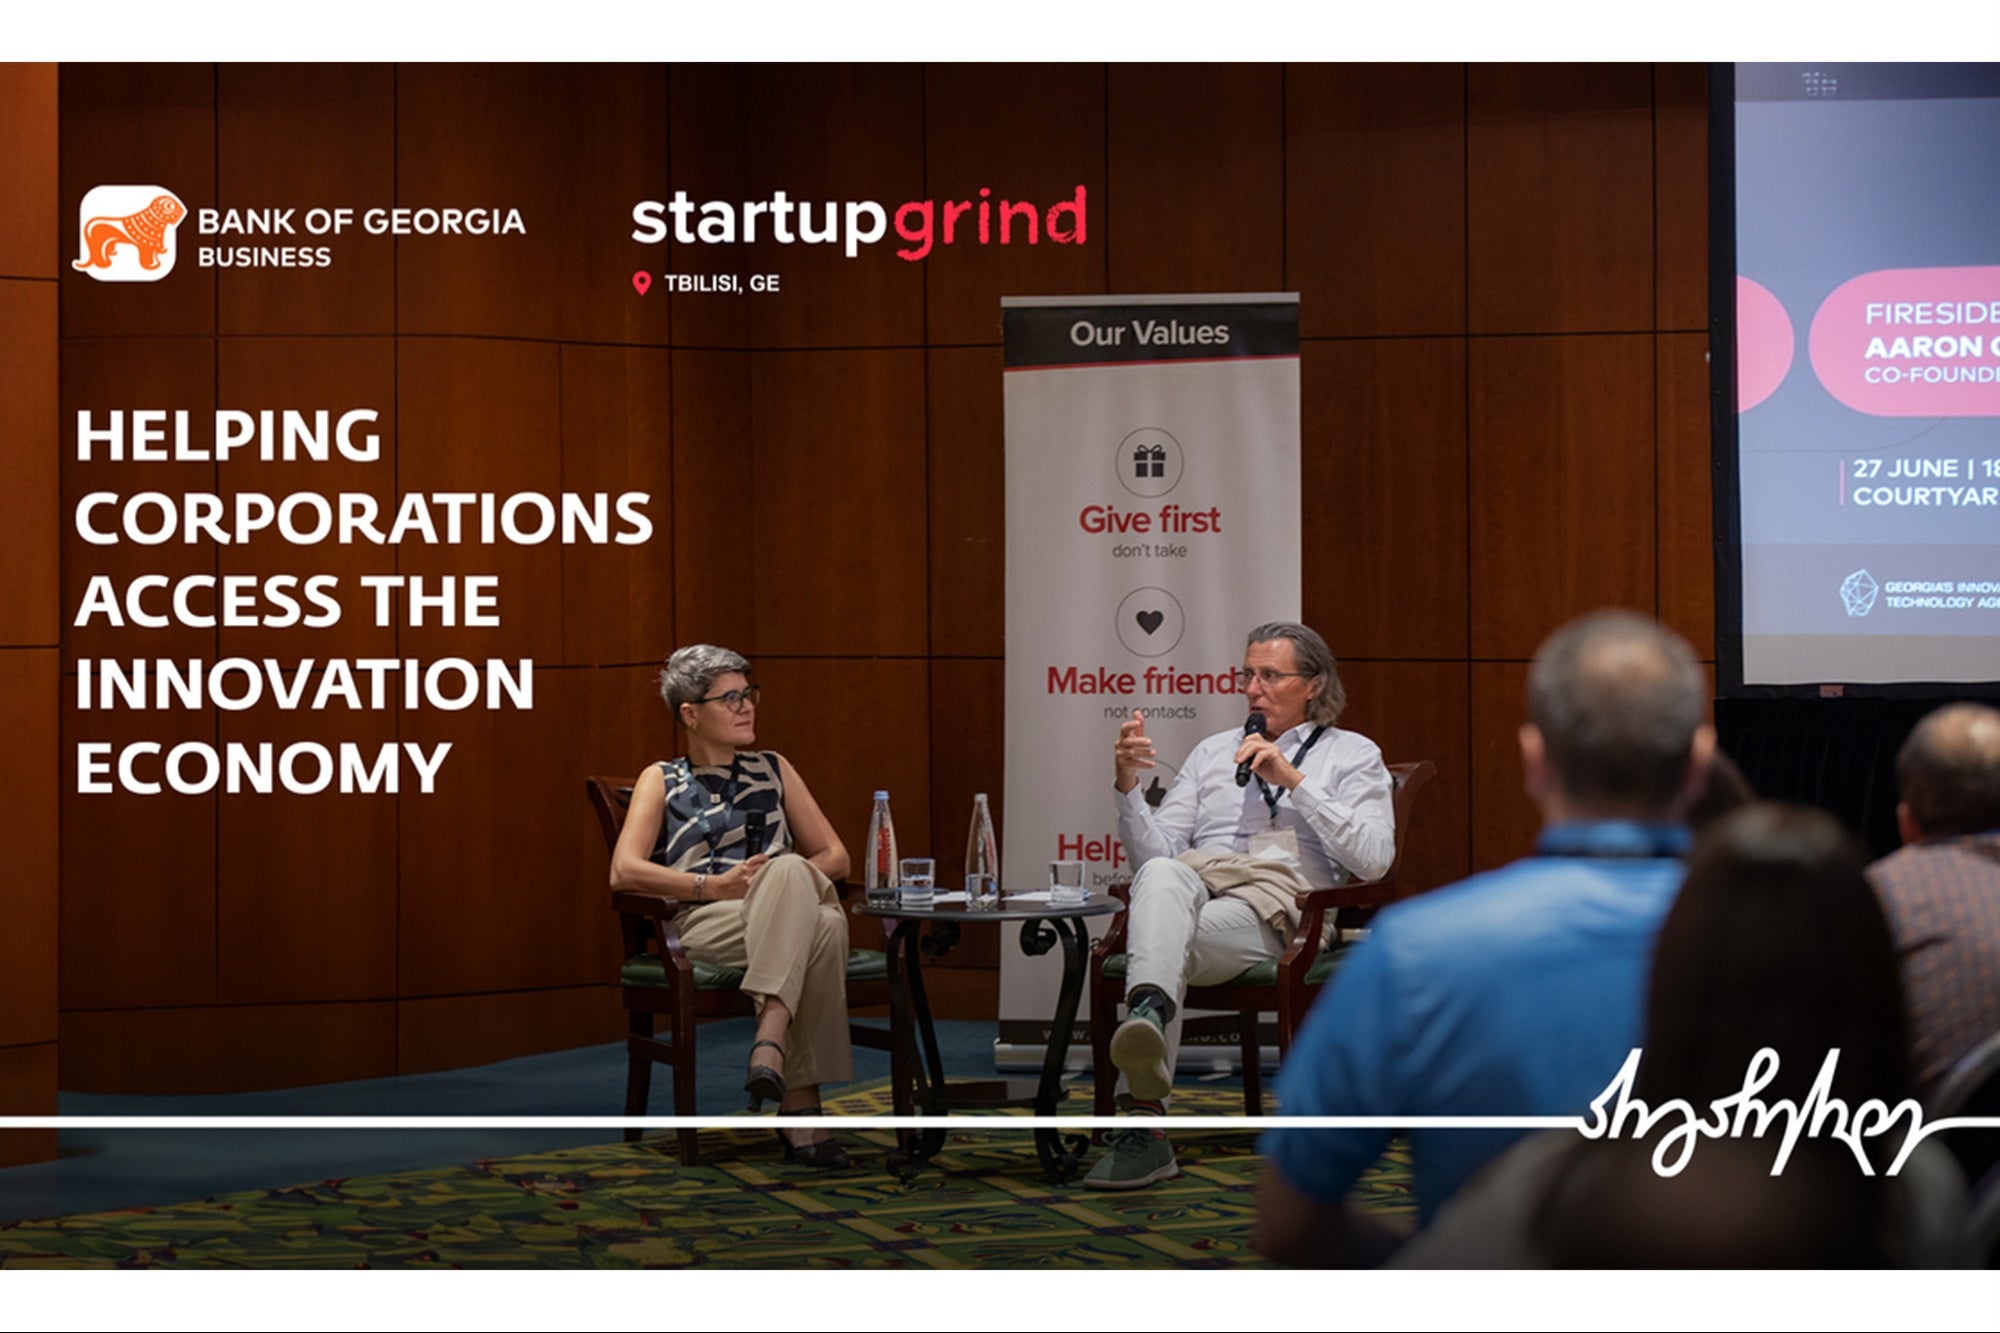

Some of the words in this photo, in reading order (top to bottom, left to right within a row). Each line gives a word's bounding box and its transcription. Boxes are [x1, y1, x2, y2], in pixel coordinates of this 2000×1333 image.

[1865, 302, 2000, 325] FIRESIDE
[1070, 320, 1126, 347] Our
[1131, 319, 1230, 345] Values
[1864, 335, 1983, 359] AARON
[1853, 458, 1883, 478] 27
[1887, 458, 1959, 478] JUNE
[1853, 486, 1998, 506] COURTYAR
[1079, 504, 1152, 534] Give
[1158, 504, 1222, 534] first
[1112, 543, 1151, 558] don't
[1155, 543, 1188, 558] take
[1886, 596, 1975, 609] TECHNOLOGY
[1047, 666, 1136, 695] Make
[1103, 707, 1129, 719] not
[1058, 833, 1126, 869] Help
